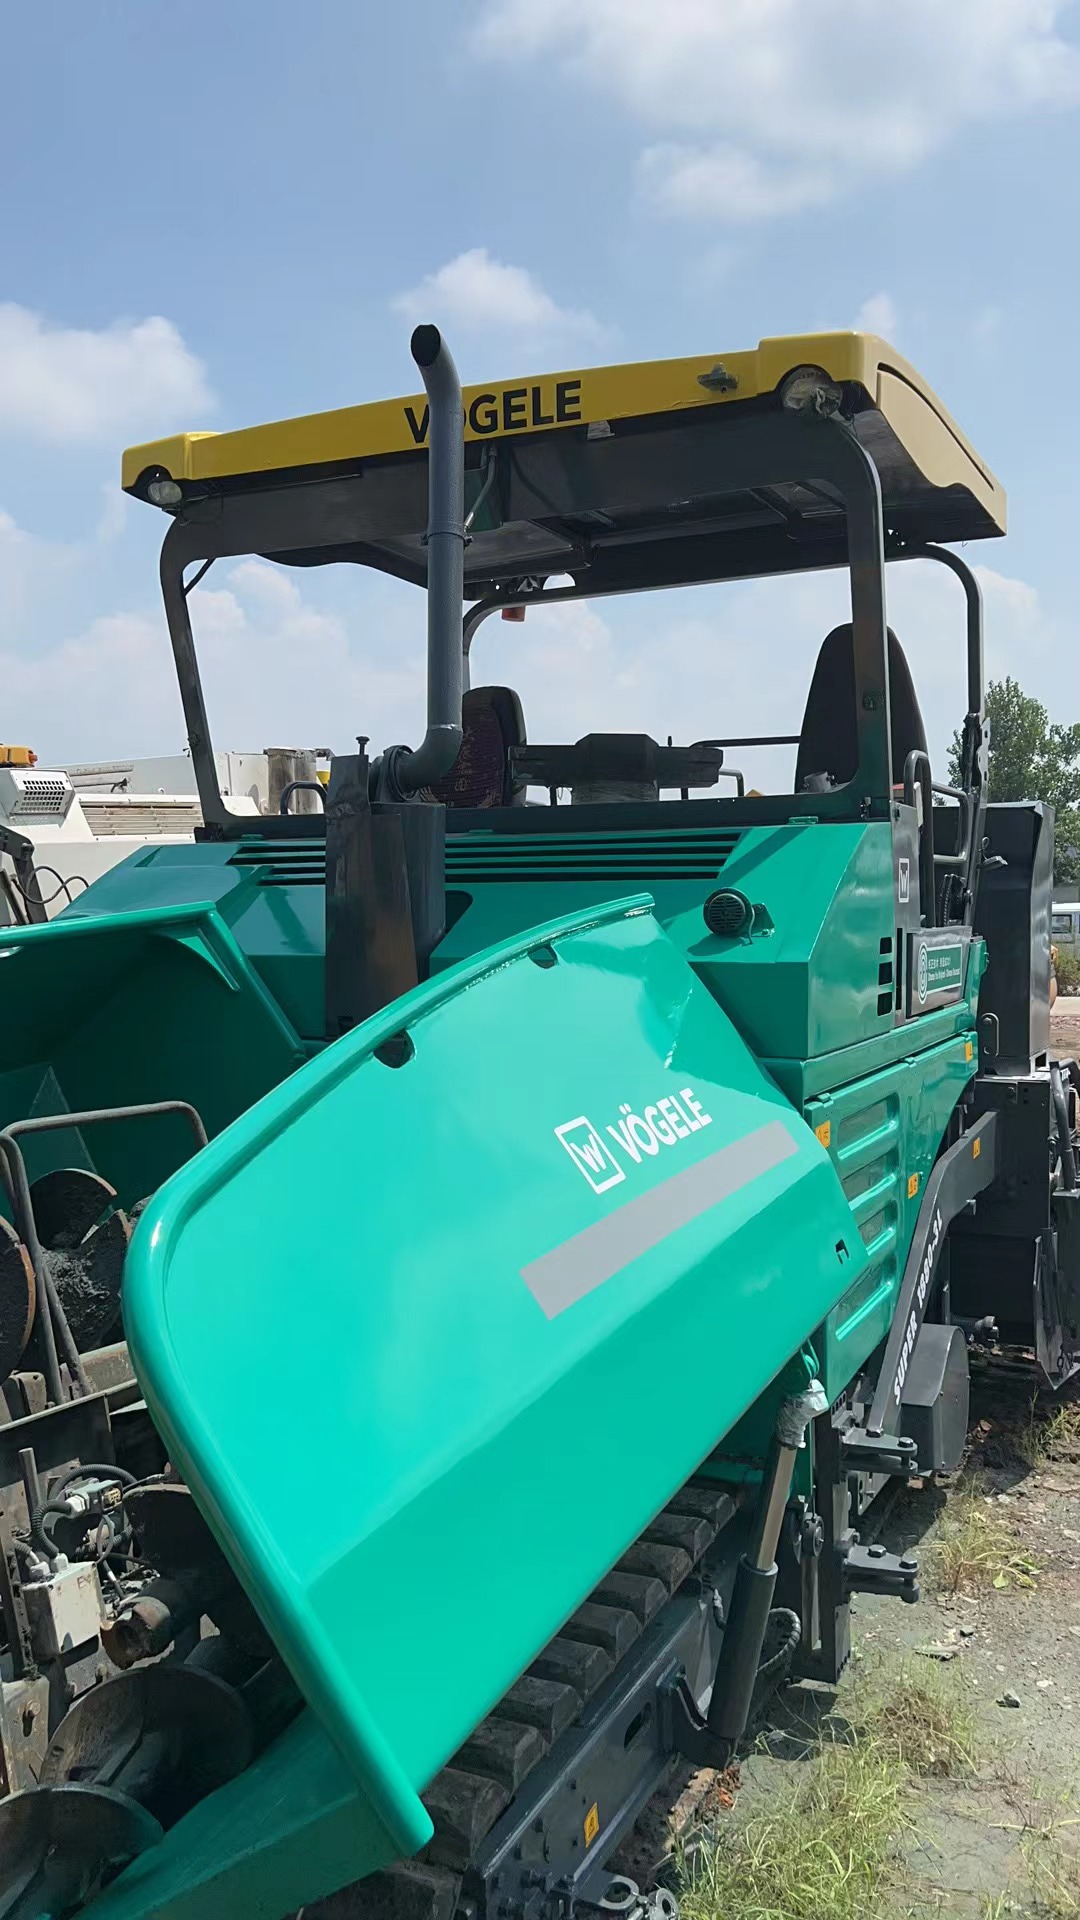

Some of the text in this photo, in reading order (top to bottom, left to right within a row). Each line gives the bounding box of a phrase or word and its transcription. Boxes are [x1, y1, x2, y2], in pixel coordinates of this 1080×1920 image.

[404, 380, 581, 444] VGELE
[605, 1087, 713, 1164] VÖGELE
[893, 1310, 917, 1405] SUPER
